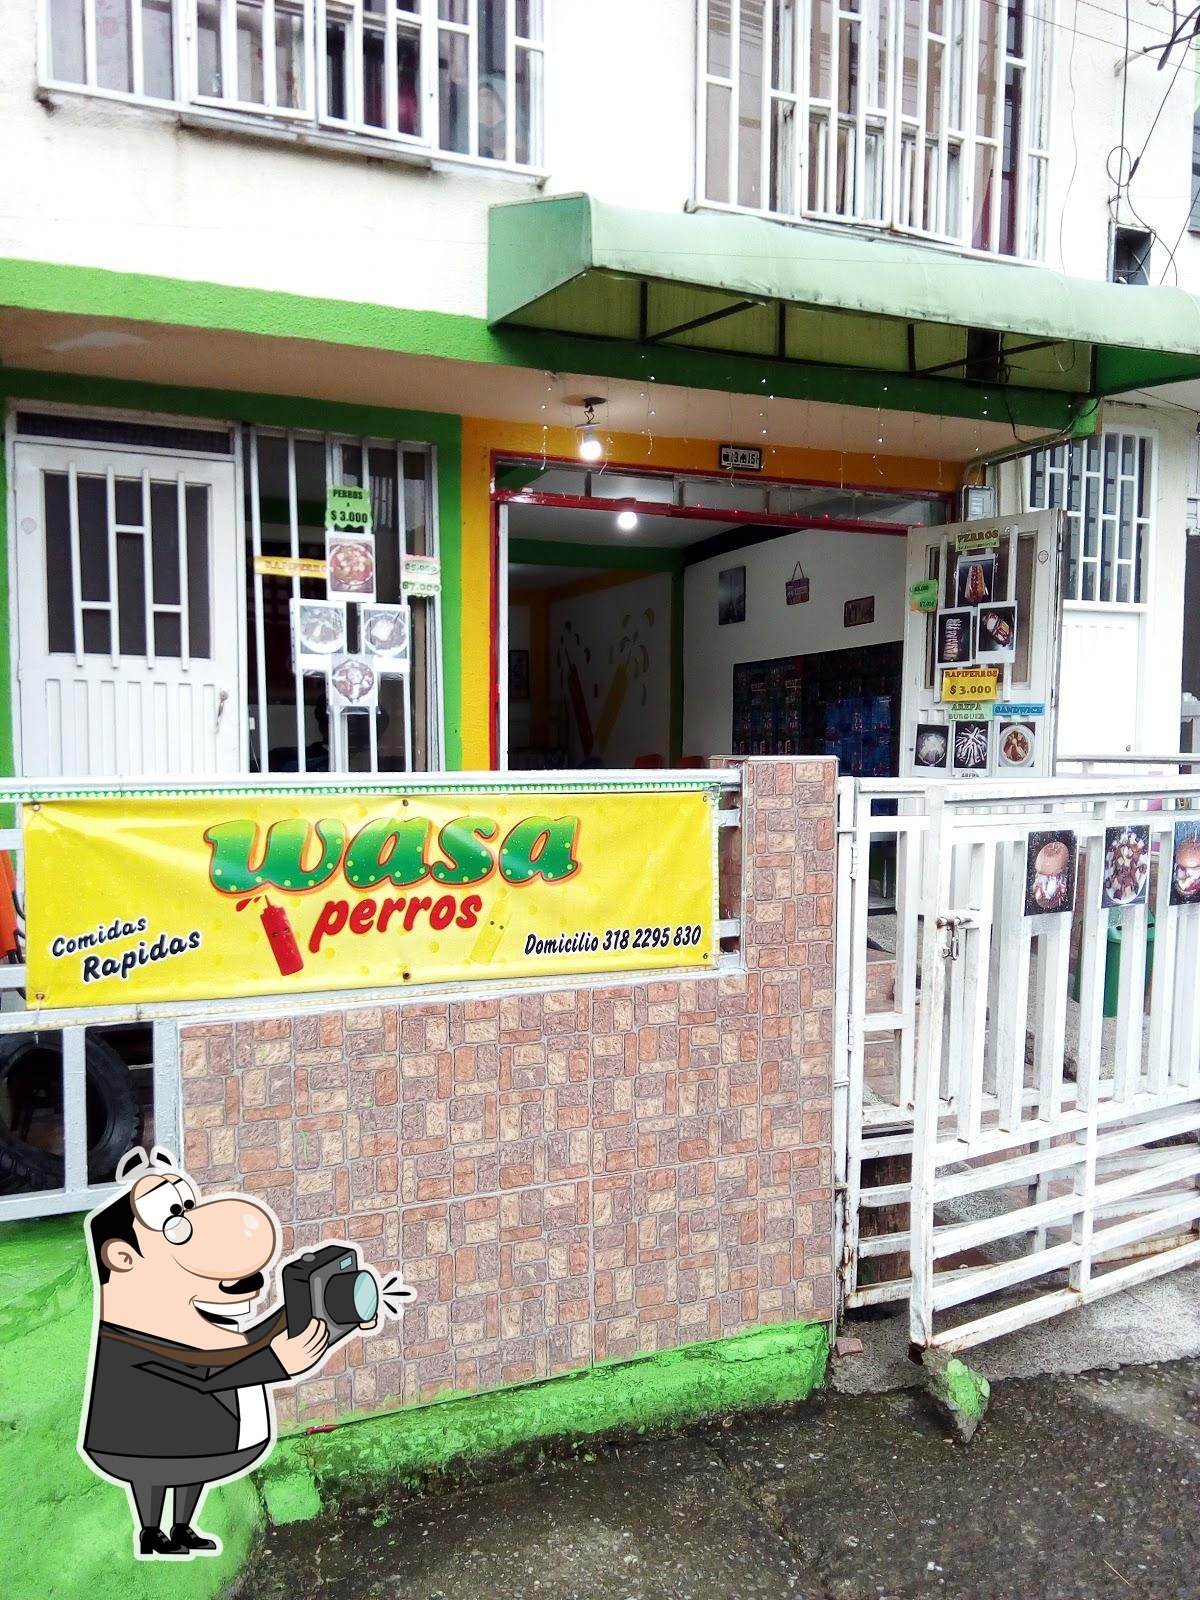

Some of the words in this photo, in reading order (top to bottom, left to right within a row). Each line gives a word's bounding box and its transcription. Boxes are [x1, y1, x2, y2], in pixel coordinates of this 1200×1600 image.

[957, 530, 999, 543] PERROS
[52, 917, 147, 957] Comidas
[308, 894, 483, 954] perros
[524, 932, 599, 955] Domicilio
[602, 929, 630, 951] 318
[632, 927, 671, 949] 2295
[673, 925, 702, 946] 830
[83, 931, 200, 982] Rapidas
